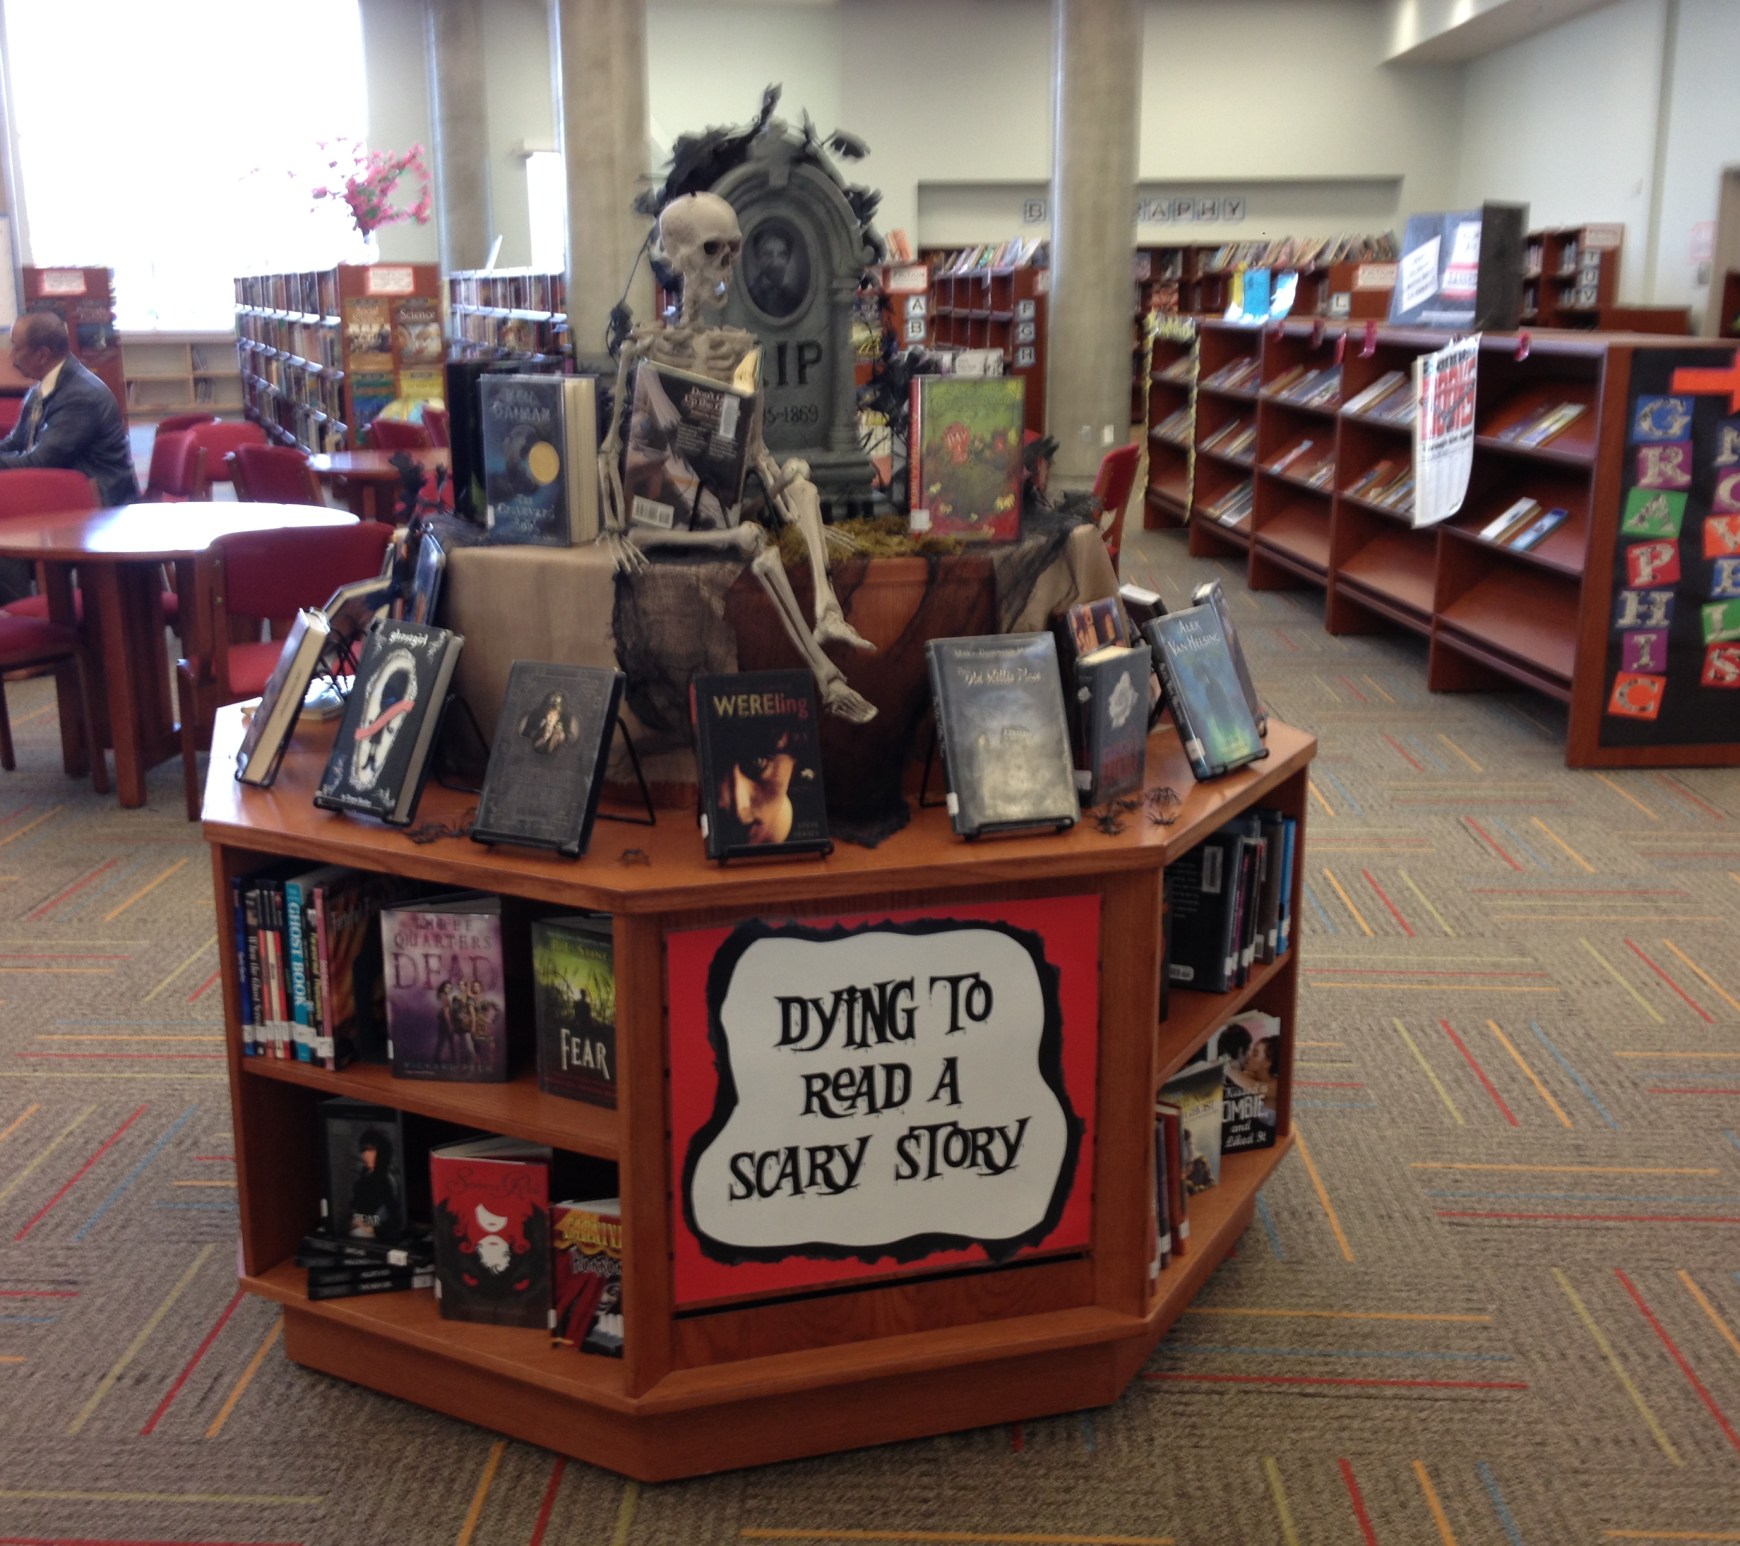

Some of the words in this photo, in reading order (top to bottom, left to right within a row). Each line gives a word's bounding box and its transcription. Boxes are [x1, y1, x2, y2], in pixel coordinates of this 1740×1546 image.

[400, 308, 436, 320] Science
[911, 298, 924, 311] A
[910, 321, 922, 333] B
[762, 339, 822, 386] IP
[388, 629, 429, 647] ghostgirl
[712, 693, 809, 719] WEREling
[393, 932, 492, 950] QUARTERS
[391, 951, 499, 990] DEAD
[929, 972, 994, 1036] TO
[560, 1028, 611, 1081] FEAR
[927, 1056, 964, 1107] A
[1230, 1120, 1252, 1133] and
[727, 1134, 874, 1205] SCARY
[895, 1116, 1033, 1183] STORY
